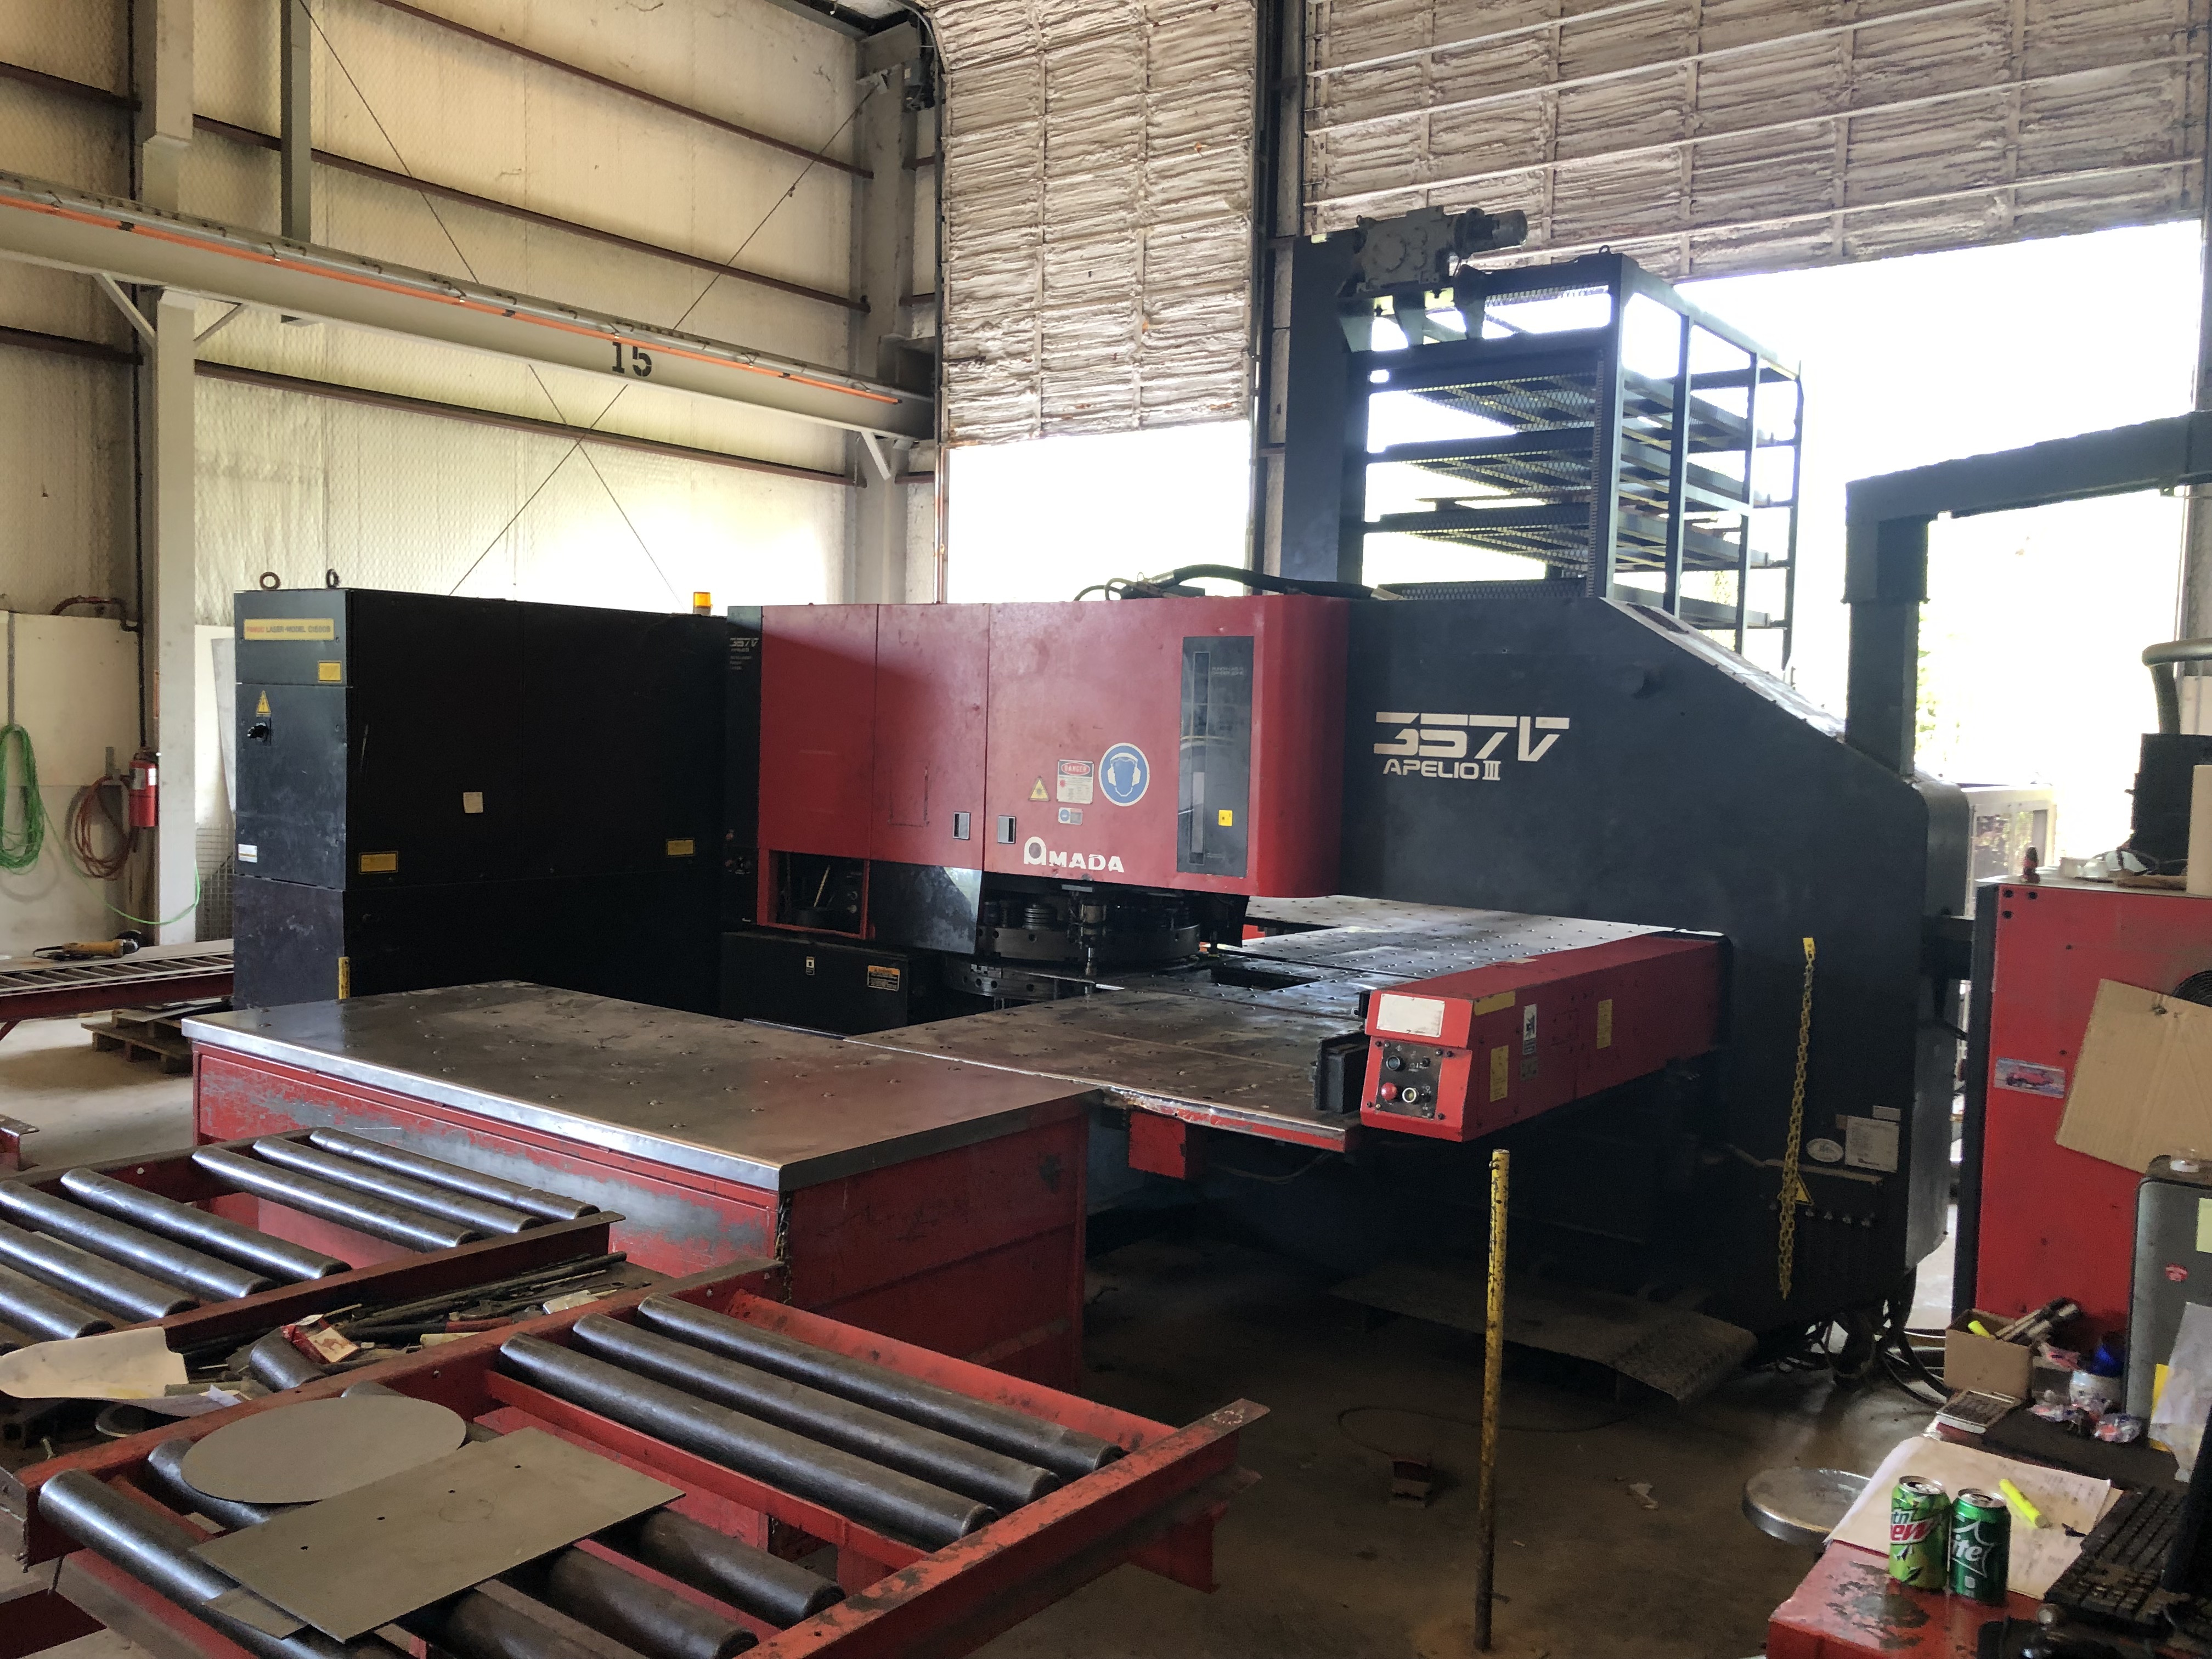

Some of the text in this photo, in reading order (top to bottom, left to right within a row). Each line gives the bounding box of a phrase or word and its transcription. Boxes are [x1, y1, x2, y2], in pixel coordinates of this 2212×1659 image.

[612, 341, 652, 377] 15
[1374, 712, 1570, 761] 357V
[1383, 759, 1479, 780] APELIO
[1024, 836, 1125, 873] AMADA
[1891, 1521, 1927, 1541] ew
